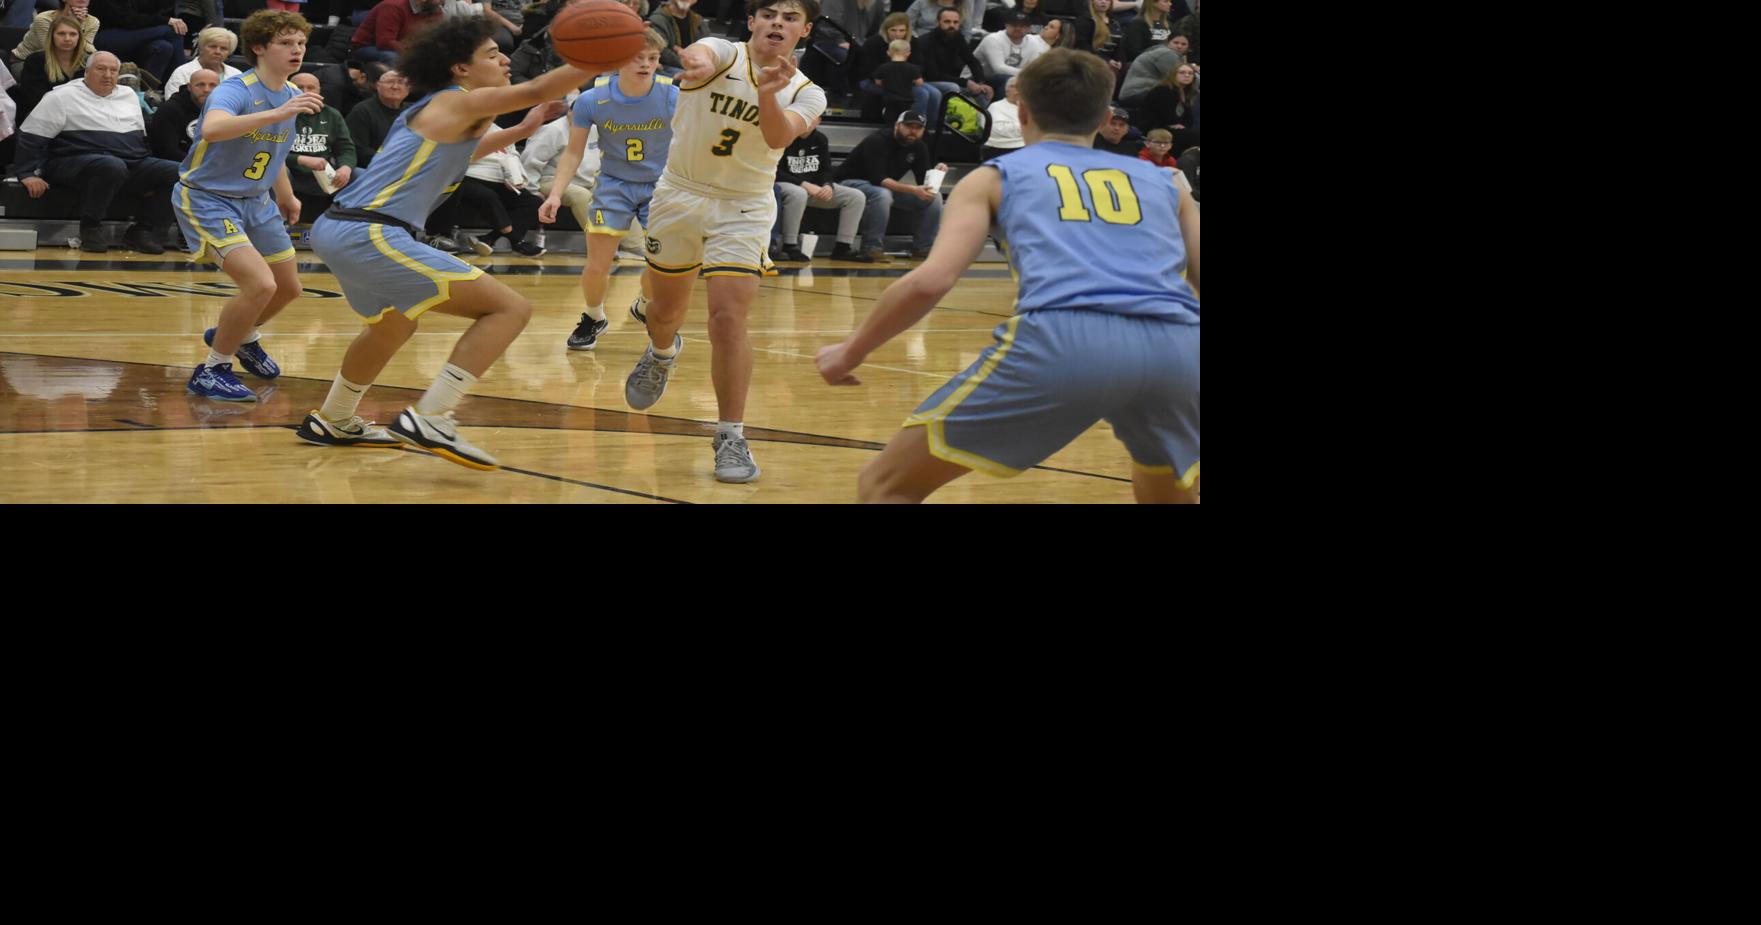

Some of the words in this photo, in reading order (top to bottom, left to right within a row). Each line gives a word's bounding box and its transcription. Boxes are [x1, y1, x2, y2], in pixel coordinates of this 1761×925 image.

[710, 92, 759, 126] TINO
[626, 138, 644, 161] 2
[711, 128, 740, 156] 3
[243, 151, 271, 180] 3
[1045, 163, 1143, 225] 10
[223, 218, 239, 234] A
[595, 209, 605, 225] A
